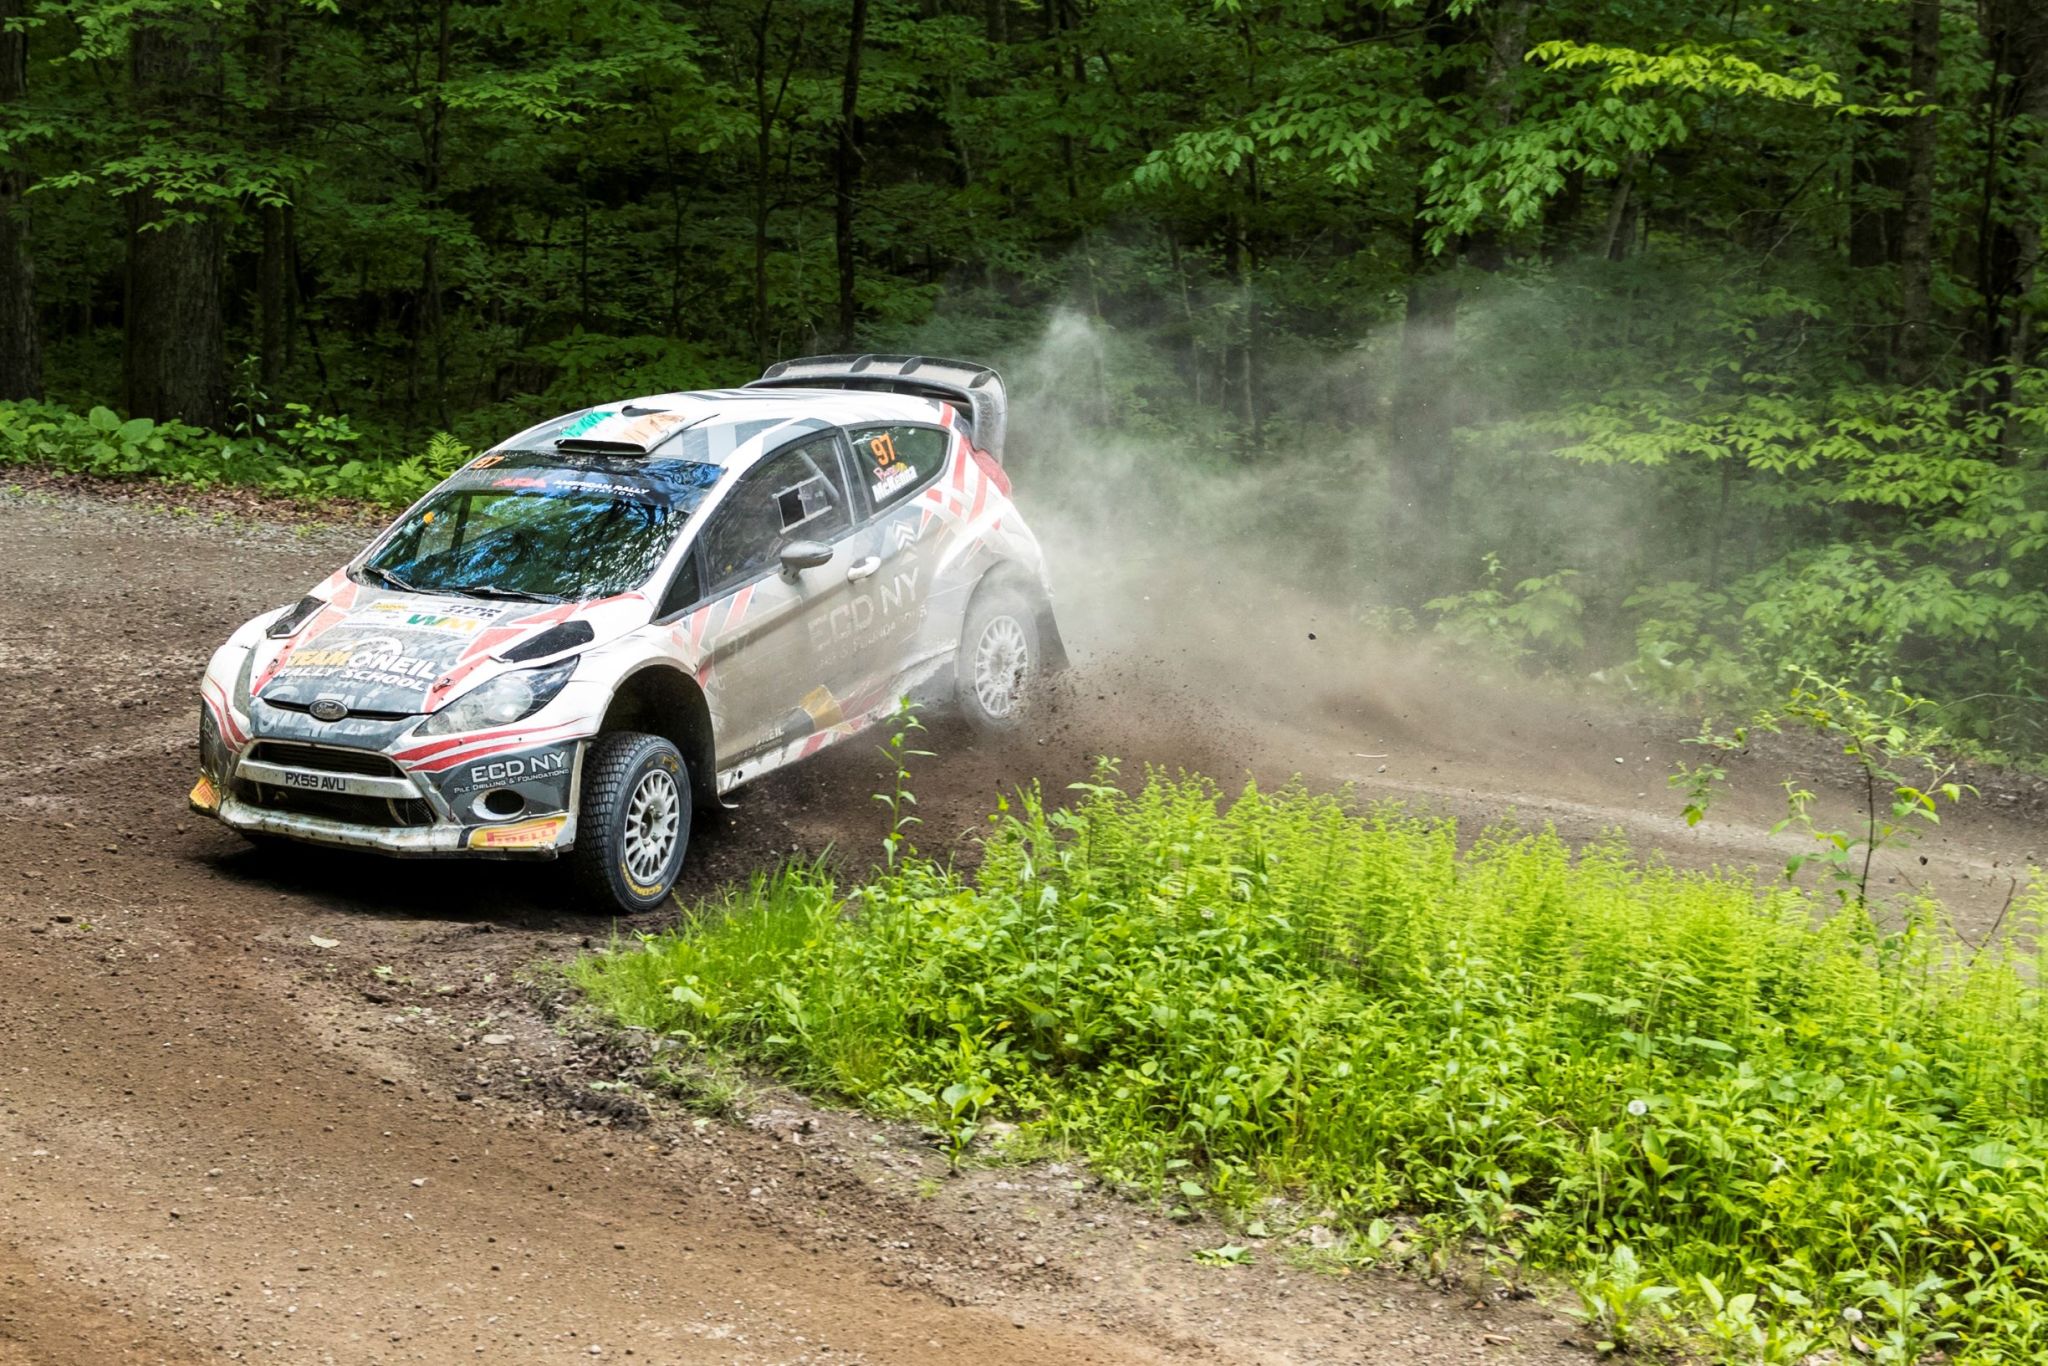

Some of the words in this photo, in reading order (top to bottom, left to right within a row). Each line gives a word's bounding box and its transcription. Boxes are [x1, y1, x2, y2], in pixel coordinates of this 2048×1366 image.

[871, 431, 896, 466] 97
[613, 484, 650, 495] RALLY
[807, 594, 875, 651] ECD
[879, 566, 919, 616] NY
[406, 614, 477, 631] WM
[286, 650, 352, 667] TEAM
[271, 667, 340, 679] RALLY
[340, 668, 426, 692] SCHOOL
[470, 759, 526, 783] ECD
[529, 751, 567, 773] NY
[285, 772, 318, 788] PX59
[321, 777, 346, 792] AVU
